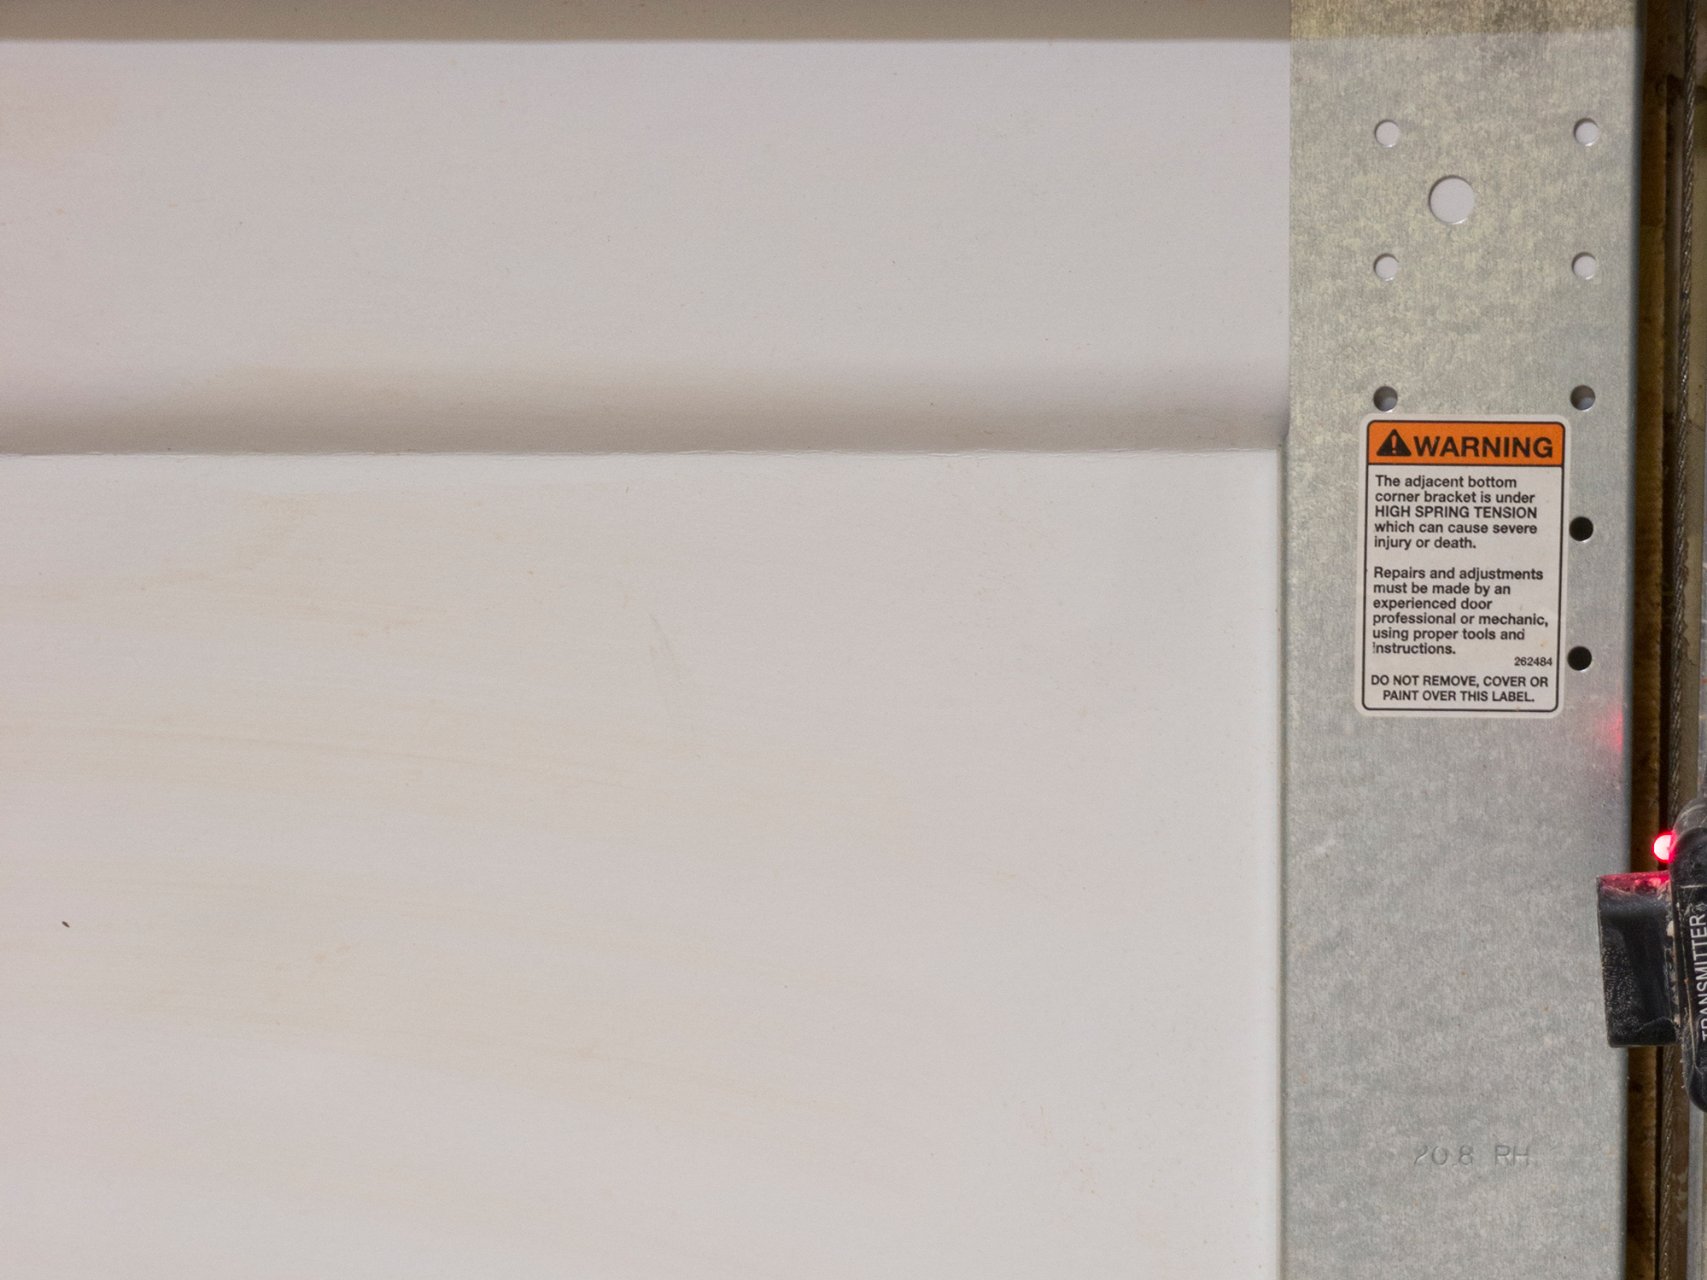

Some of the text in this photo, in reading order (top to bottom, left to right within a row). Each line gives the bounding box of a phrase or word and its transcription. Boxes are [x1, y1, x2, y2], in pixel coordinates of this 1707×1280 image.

[1413, 436, 1553, 458] WARNING
[1376, 475, 1516, 491] The adjacent bottom
[1376, 491, 1535, 503] corner bracket is under
[1375, 505, 1537, 518] HIGH SPRING TENSION
[1375, 521, 1537, 534] which can cause severe
[1374, 537, 1476, 550] injury or death.
[1374, 567, 1544, 582] Repairs and adjustments
[1374, 582, 1510, 596] must be made by an
[1373, 597, 1492, 611] experienced door
[1373, 612, 1549, 627] professional or mechanic,
[1373, 628, 1524, 643] using proper tools and
[1373, 643, 1455, 654] instructions.
[1514, 657, 1552, 666] 262484
[1372, 675, 1548, 688] DO NOT REMOVE, COVER OR
[1383, 690, 1534, 702] PAINT OVER THIS LABEL.
[1494, 1144, 1530, 1166] RH
